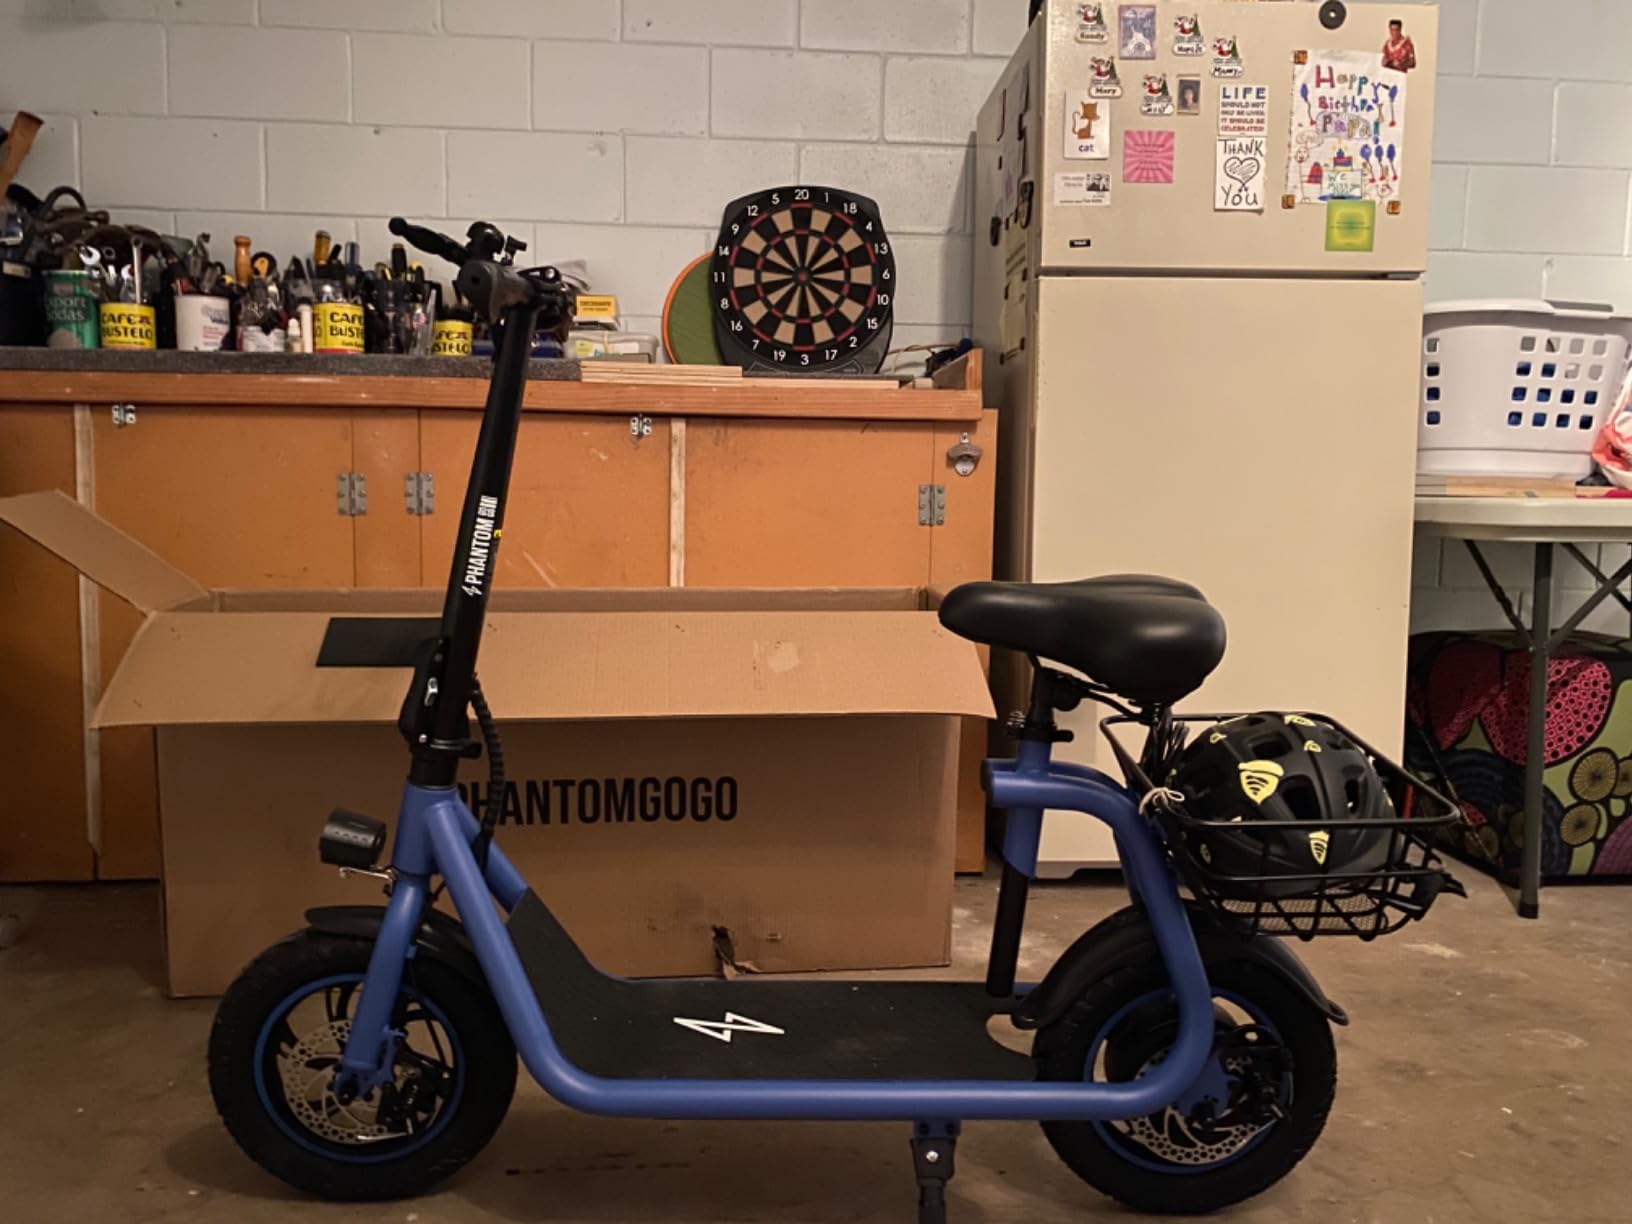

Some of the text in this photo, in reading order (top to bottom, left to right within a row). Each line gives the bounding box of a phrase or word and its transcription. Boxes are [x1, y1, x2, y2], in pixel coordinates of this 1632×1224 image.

[1315, 64, 1381, 104] Happy
[1222, 87, 1266, 99] LIFE
[1078, 144, 1094, 153] cat
[772, 193, 780, 204] 5
[795, 189, 809, 200] 20
[747, 205, 759, 216] 12
[843, 202, 858, 214] 18
[732, 224, 739, 235] 9
[866, 221, 873, 232] 4
[719, 246, 730, 256] 14
[874, 243, 888, 254] 13
[713, 271, 725, 283] 11
[882, 269, 890, 280] 6
[721, 298, 729, 308] 8
[877, 294, 889, 305] 10
[731, 320, 743, 332] 16
[867, 318, 878, 329] 15
[752, 339, 759, 350] 7
[849, 337, 858, 347] 2
[774, 350, 786, 361] 19
[800, 354, 809, 366] 3
[825, 349, 837, 360] 17
[465, 517, 494, 585] PHANTOM
[457, 775, 738, 826] HANTOMGOGO
